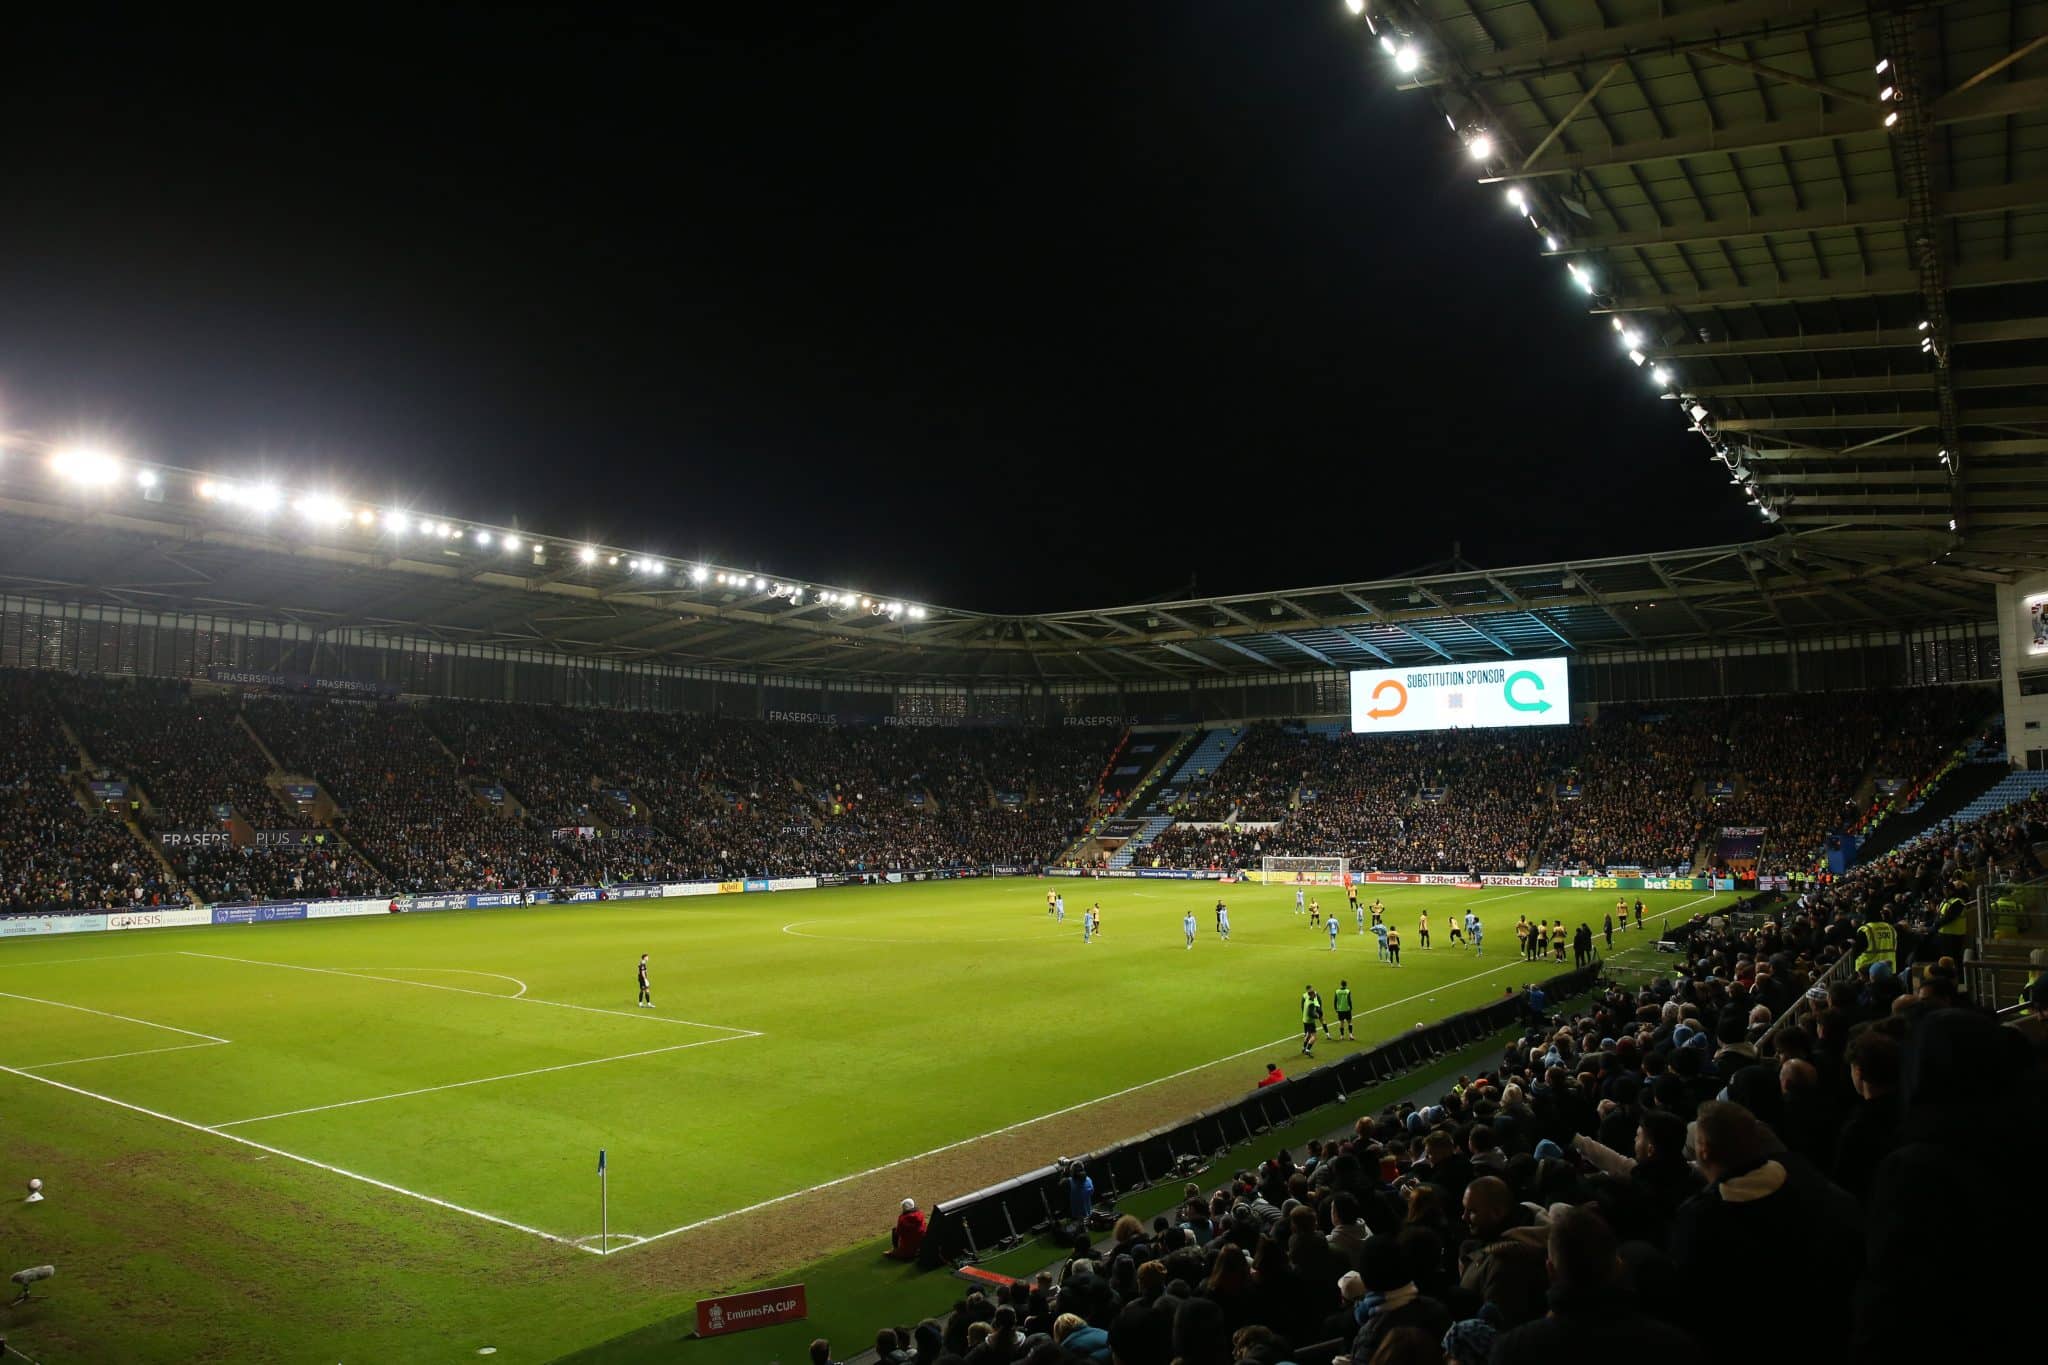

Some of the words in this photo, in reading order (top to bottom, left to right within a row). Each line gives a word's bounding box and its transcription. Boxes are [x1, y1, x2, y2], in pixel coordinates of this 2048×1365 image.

[1407, 671, 1463, 689] SUBSTITUTION
[1466, 668, 1505, 685] SPONSOR
[256, 832, 290, 845] PLUS
[1099, 869, 1108, 877] XL
[1109, 869, 1137, 877] MOTORS
[1425, 875, 1456, 885] 32Red
[1457, 876, 1489, 885] 32d
[1490, 877, 1523, 886] 32Red
[1524, 878, 1557, 887] 32Red
[1571, 877, 1618, 889] bet365
[1644, 878, 1693, 890] bet365
[501, 891, 535, 905] area
[110, 914, 161, 928] GENESIS
[726, 1308, 762, 1321] Emirates
[762, 1304, 775, 1316] FA
[776, 1300, 797, 1312] CUP
